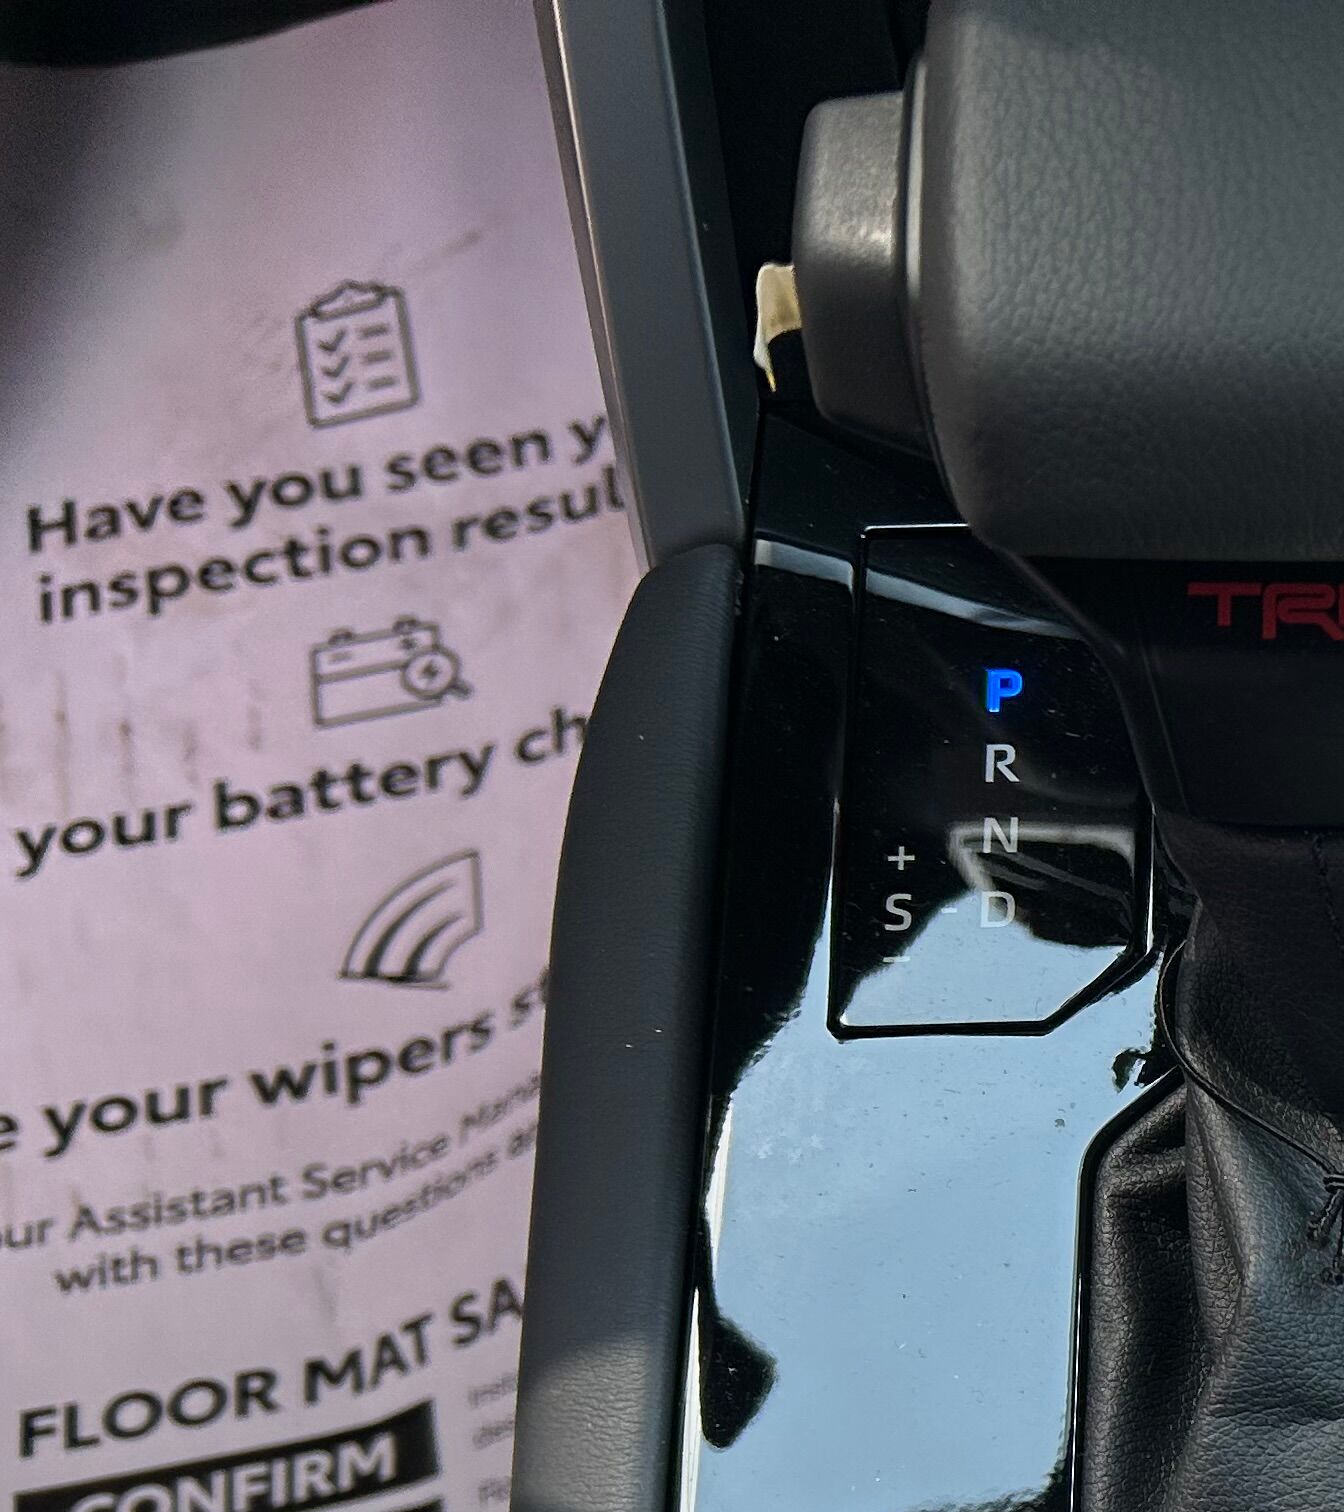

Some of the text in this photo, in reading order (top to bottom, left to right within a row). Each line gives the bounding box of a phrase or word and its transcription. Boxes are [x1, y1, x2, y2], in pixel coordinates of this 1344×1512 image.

[25, 485, 204, 552] Have
[225, 463, 362, 527] you
[386, 428, 551, 494] seen
[38, 466, 626, 623] inspection resul
[985, 668, 1023, 712] P
[15, 743, 494, 879] your battery
[985, 743, 1020, 783] R
[982, 816, 1019, 853] N
[883, 892, 913, 932] S
[979, 889, 1016, 928] D
[43, 1009, 495, 1158] your wipers
[54, 1149, 499, 1293] with these questions
[68, 1171, 287, 1243] Assistant
[302, 1132, 449, 1201] Service
[19, 1314, 434, 1459] FLOOR MAT
